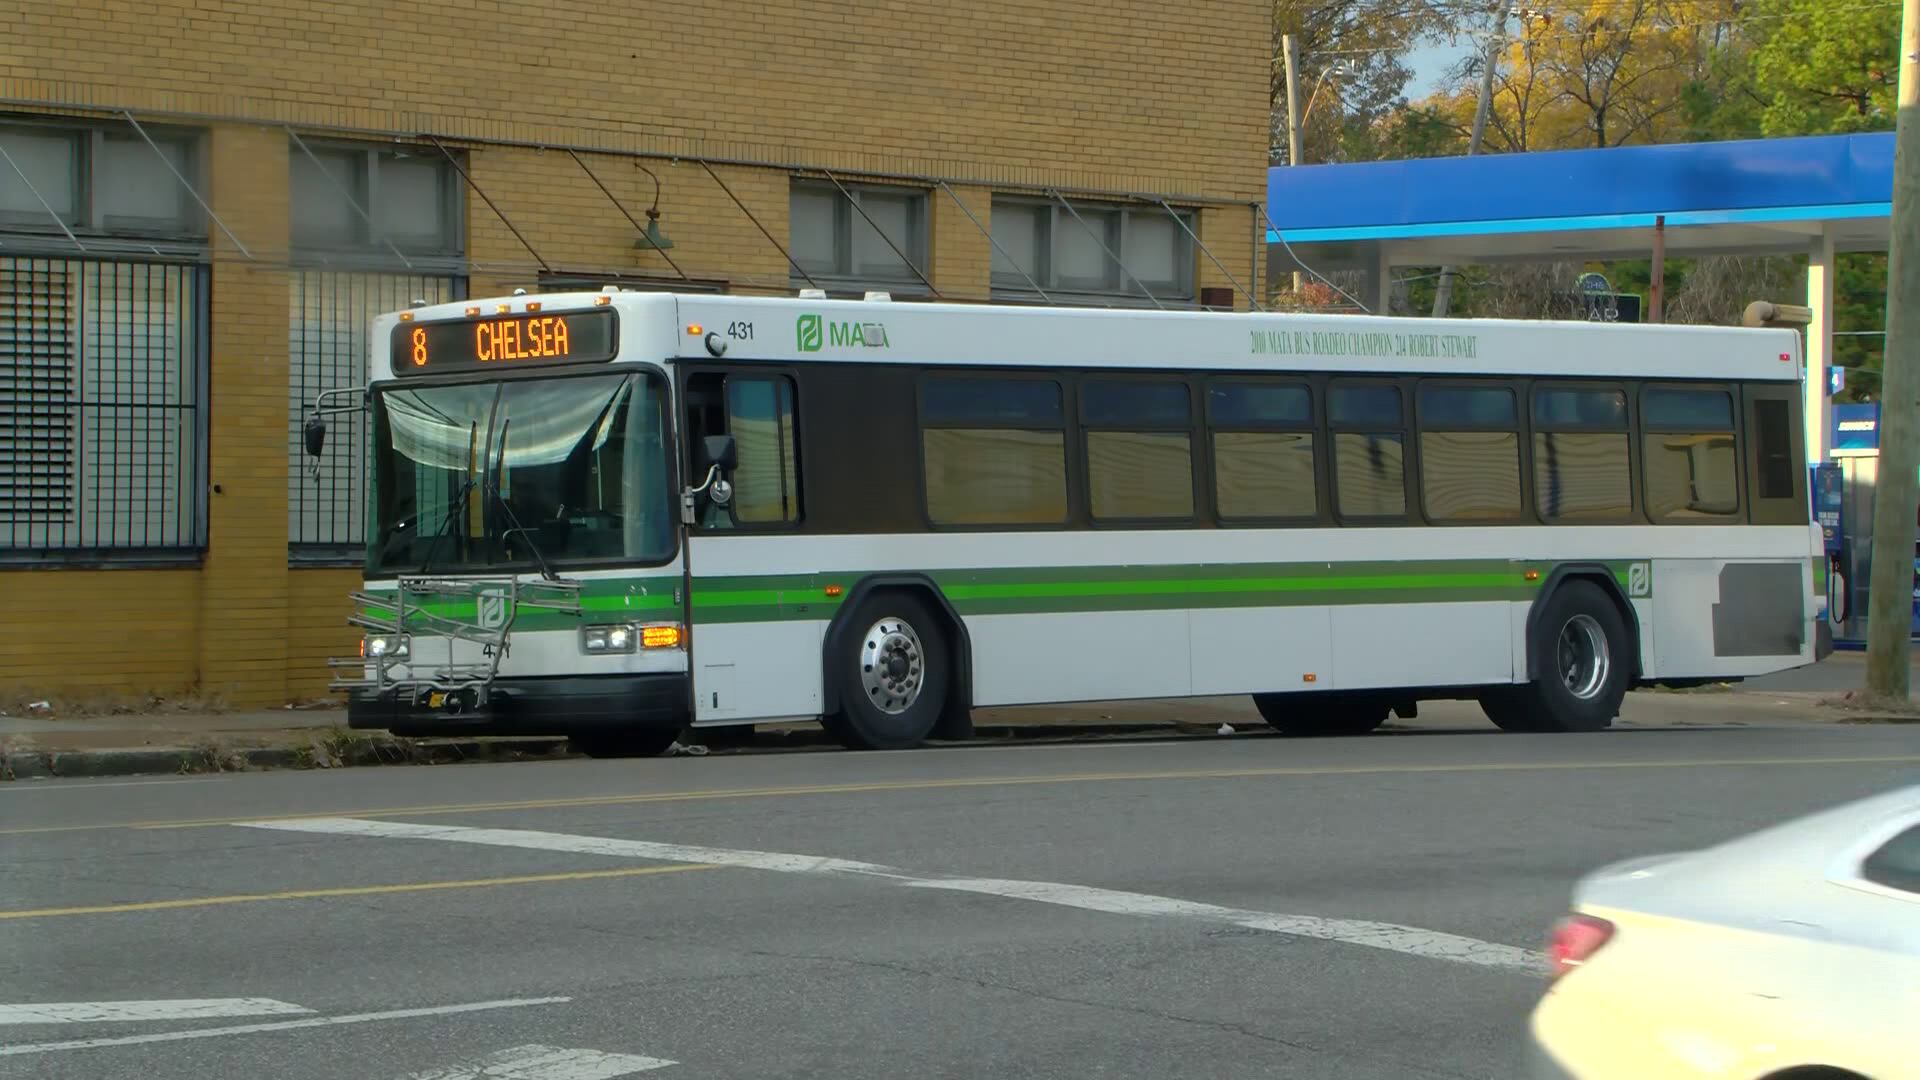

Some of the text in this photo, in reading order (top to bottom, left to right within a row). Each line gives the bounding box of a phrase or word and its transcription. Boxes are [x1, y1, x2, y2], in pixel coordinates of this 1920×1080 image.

[412, 317, 569, 366] 8 CHELSEA
[727, 321, 754, 340] 431
[830, 322, 890, 348] MA
[1294, 331, 1311, 355] BUS
[1348, 332, 1393, 356] CHAMPION
[1409, 334, 1440, 358] ROBERT
[1442, 335, 1477, 358] STEWART
[483, 643, 510, 659] 41
